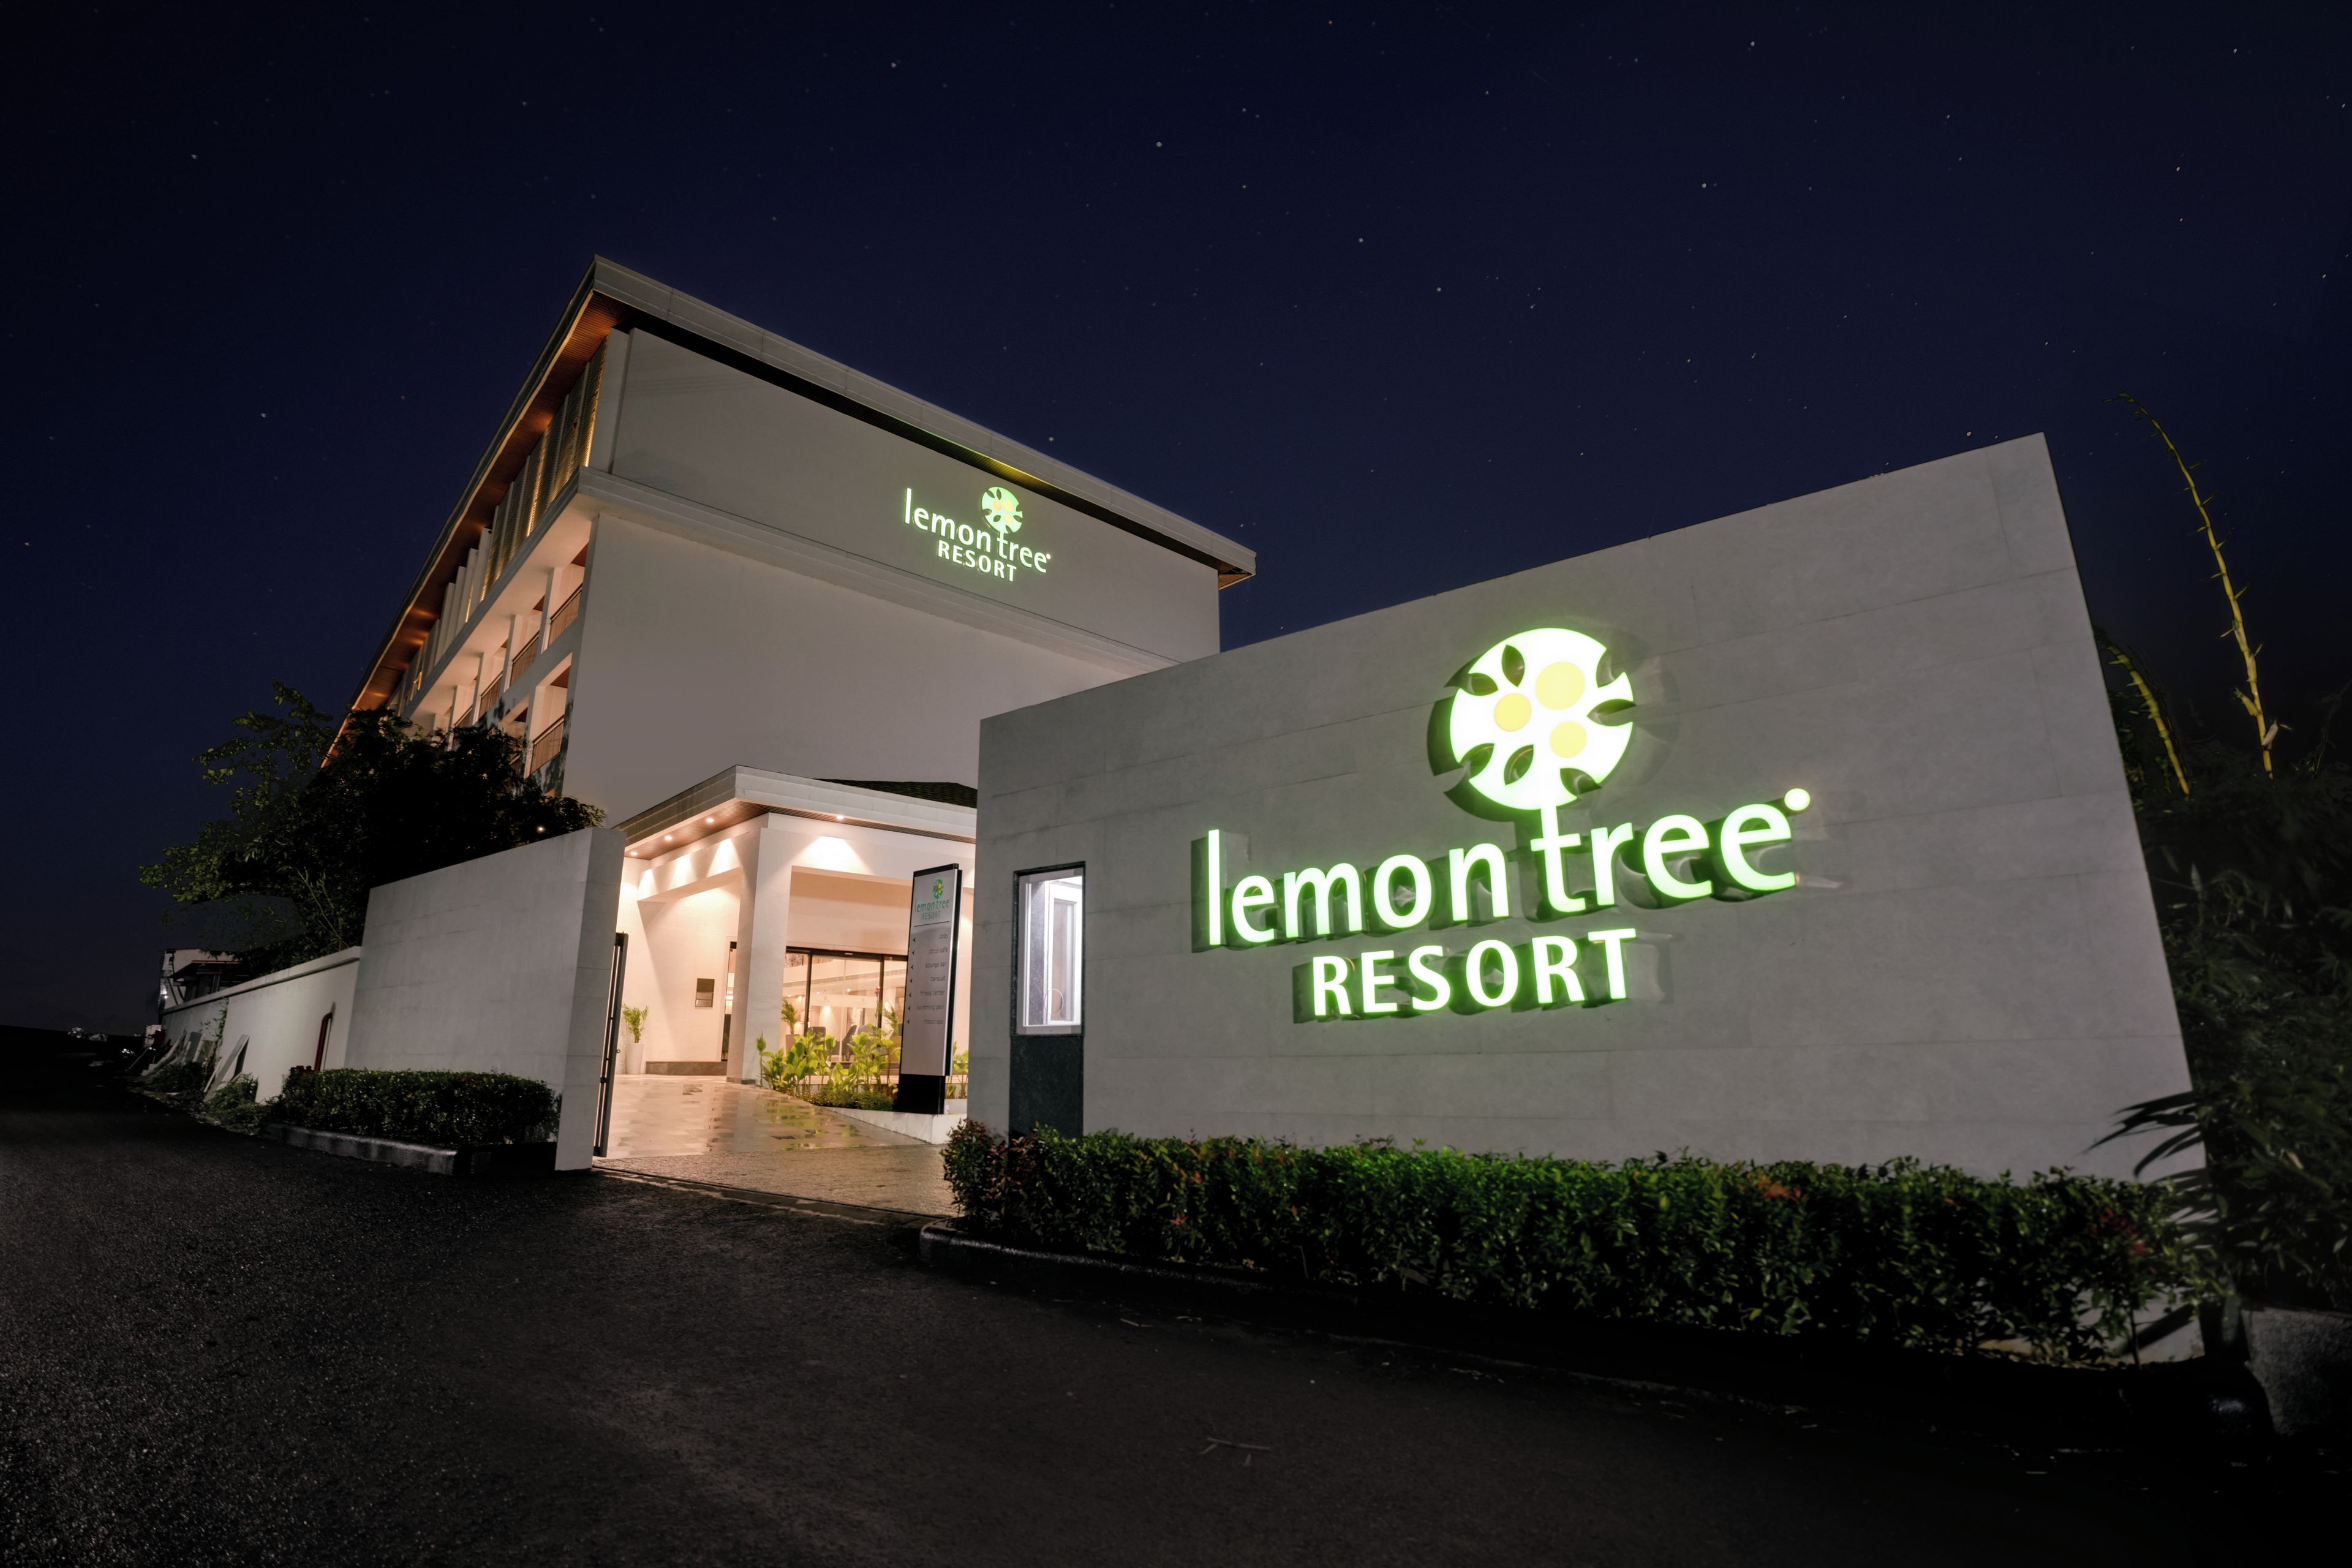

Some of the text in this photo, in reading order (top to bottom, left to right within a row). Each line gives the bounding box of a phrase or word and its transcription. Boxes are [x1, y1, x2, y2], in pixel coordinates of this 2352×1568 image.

[905, 488, 1047, 573] lemon tree
[938, 540, 1017, 582] RESORT
[914, 899, 950, 912] lemon tree
[1208, 803, 1795, 946] lemon tree
[1313, 928, 1636, 1016] RESORT
